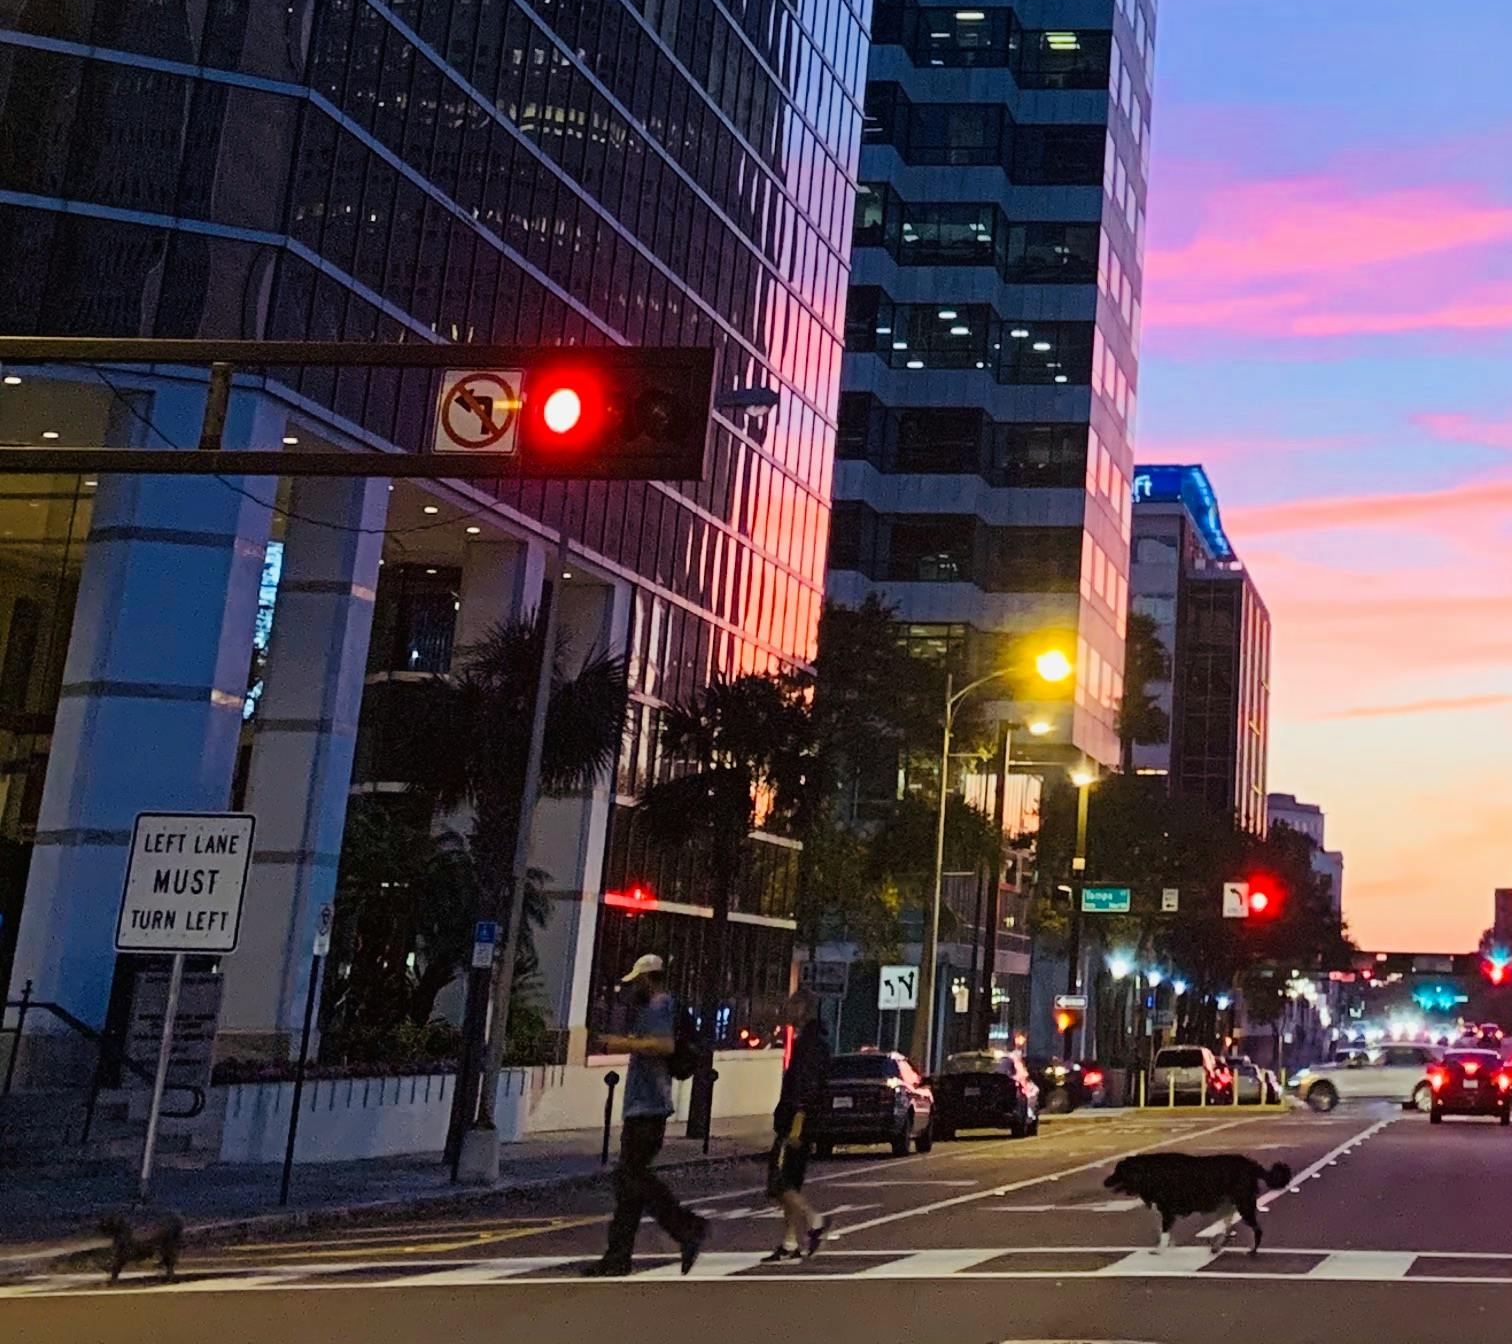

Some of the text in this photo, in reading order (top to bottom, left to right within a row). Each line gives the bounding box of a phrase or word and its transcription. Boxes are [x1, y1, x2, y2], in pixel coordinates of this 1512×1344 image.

[144, 833, 240, 854] LEFT LANE
[153, 869, 219, 895] MUST
[131, 910, 229, 931] TURN LEFT
